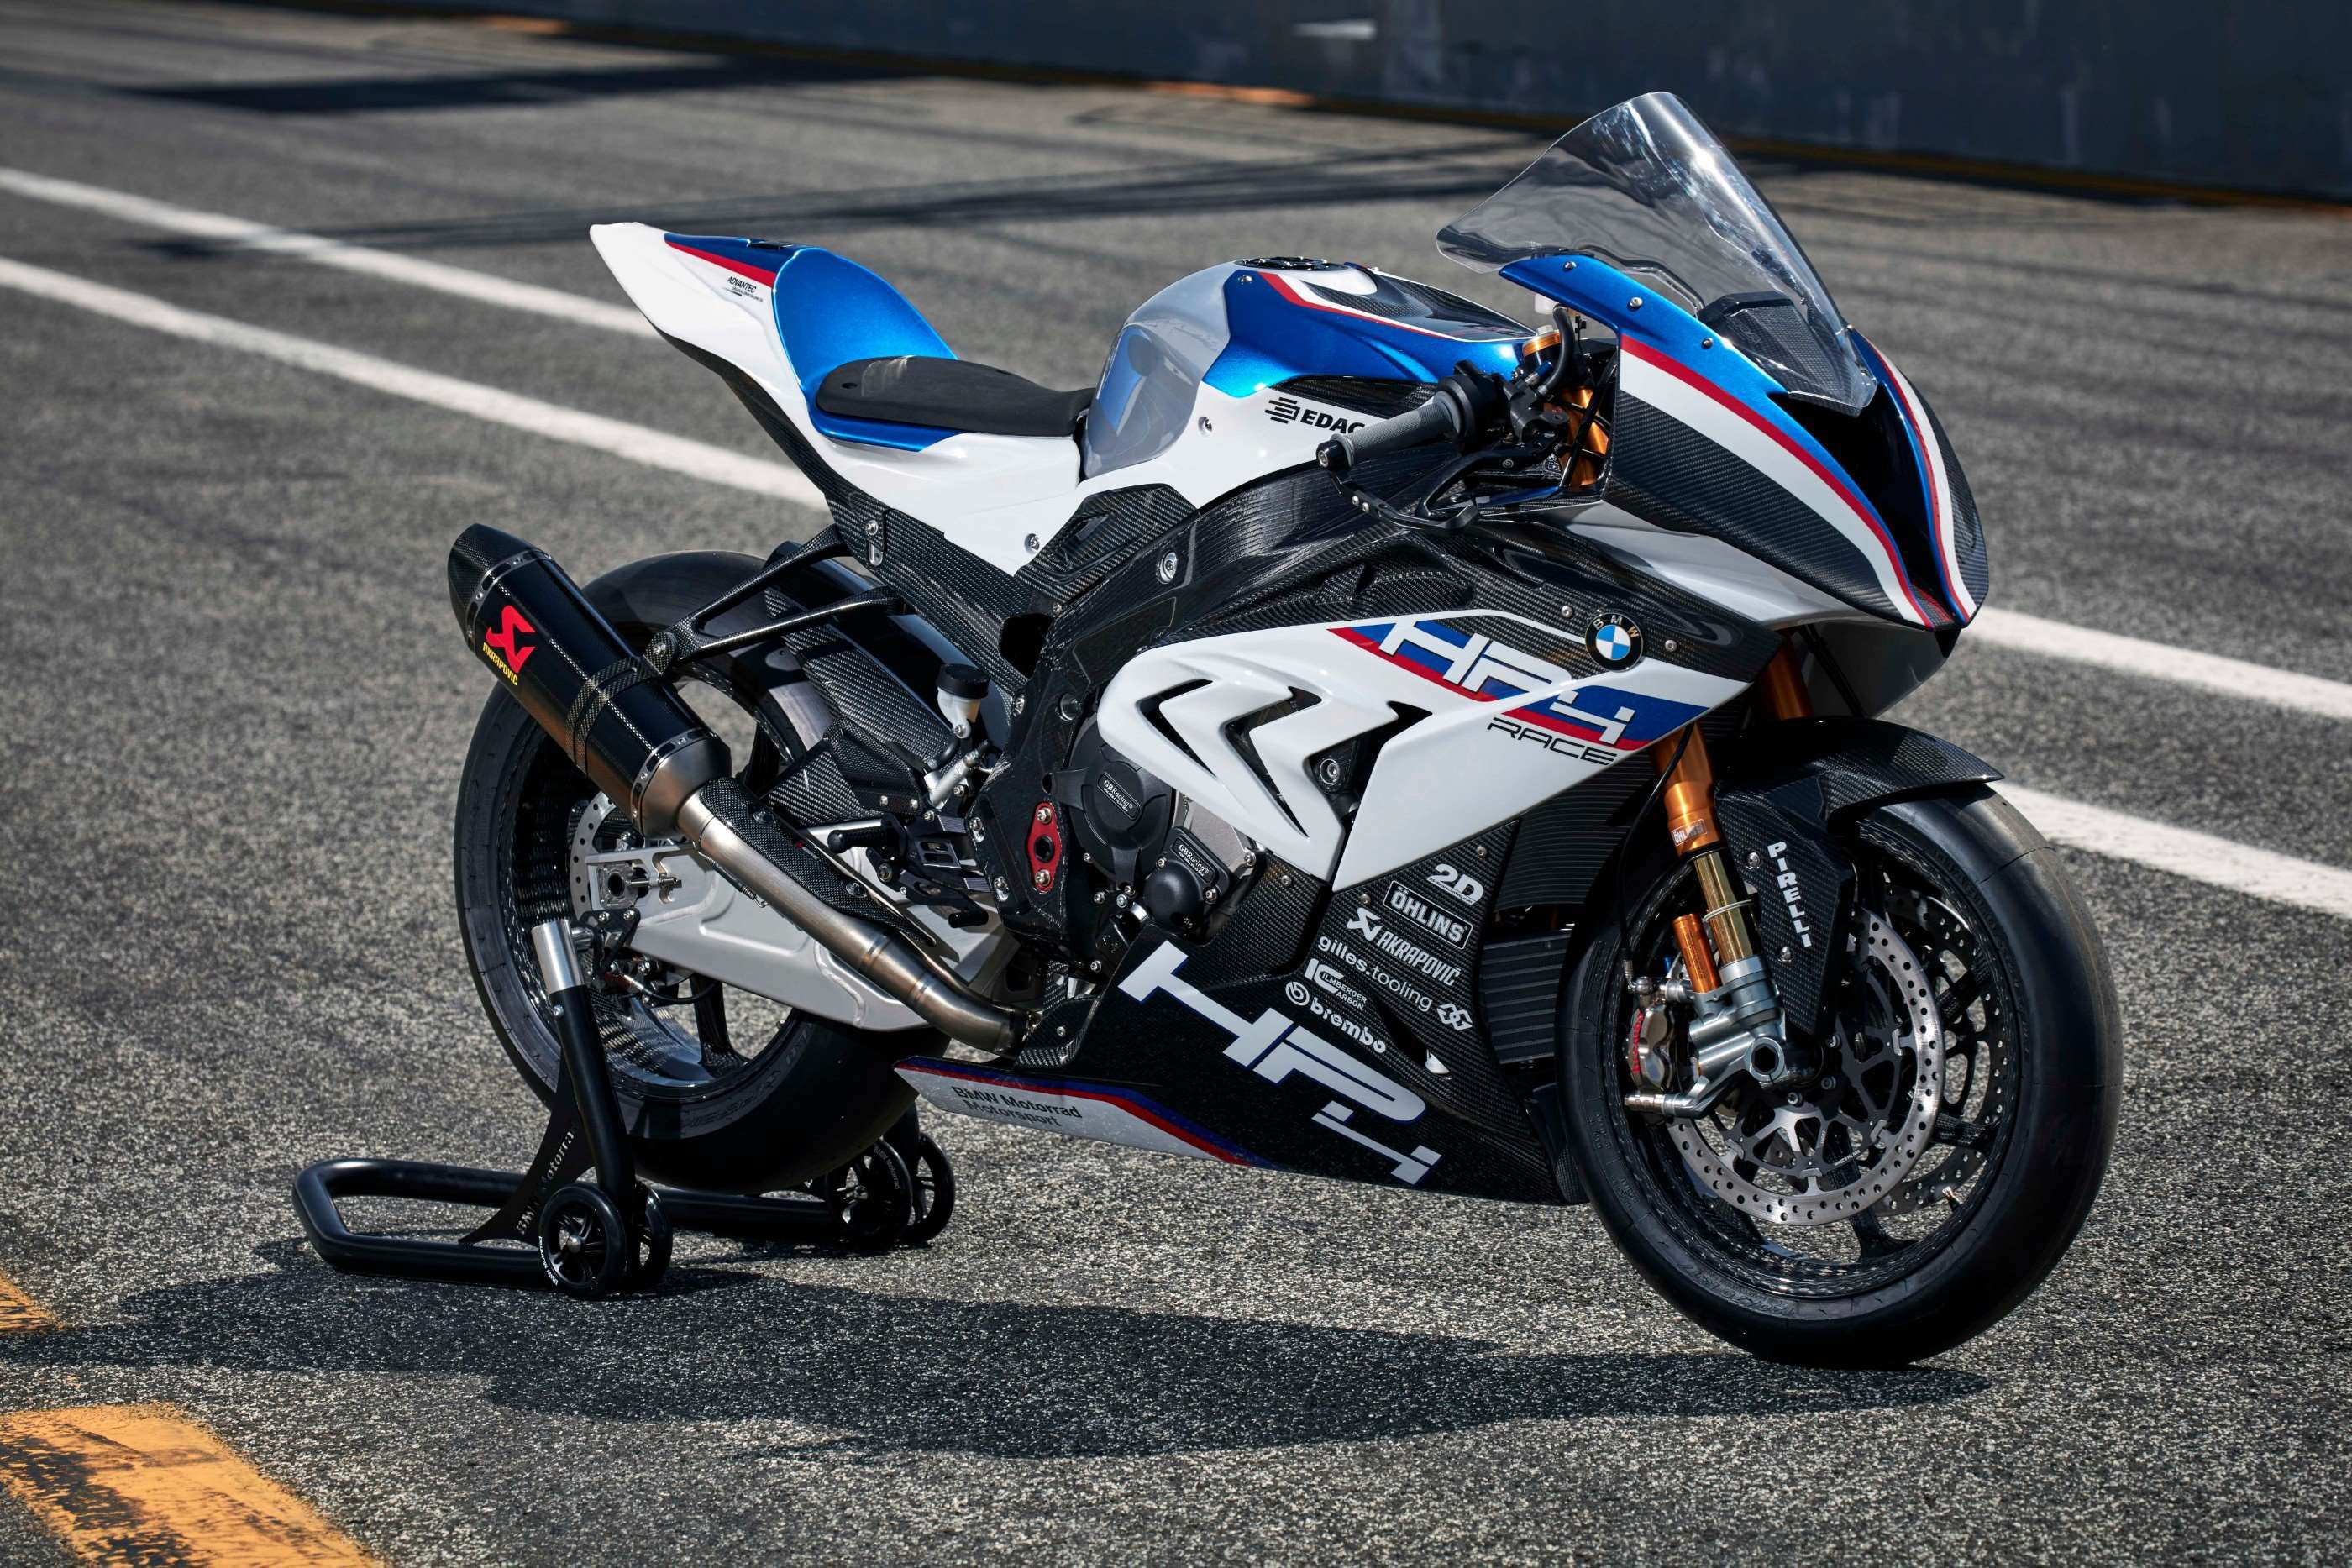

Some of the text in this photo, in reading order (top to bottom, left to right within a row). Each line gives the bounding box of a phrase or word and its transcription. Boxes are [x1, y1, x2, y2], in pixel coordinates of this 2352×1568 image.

[727, 276, 757, 293] ADVANTEC
[1593, 615, 1641, 638] BMW
[1378, 620, 1636, 746] HP4
[1488, 717, 1617, 766] RACE
[1426, 863, 1484, 905] 2D
[1767, 842, 1813, 948] PIRELLI
[1390, 886, 1466, 944] ÖHLINS
[1317, 935, 1433, 1013] gilles.tooling
[1321, 973, 1368, 1004] ILMBERGER
[1310, 996, 1387, 1053] brembo
[1117, 940, 1442, 1185] HP4
[951, 1086, 1083, 1119] BMW Motorrad
[963, 1099, 1063, 1127] Motorsport
